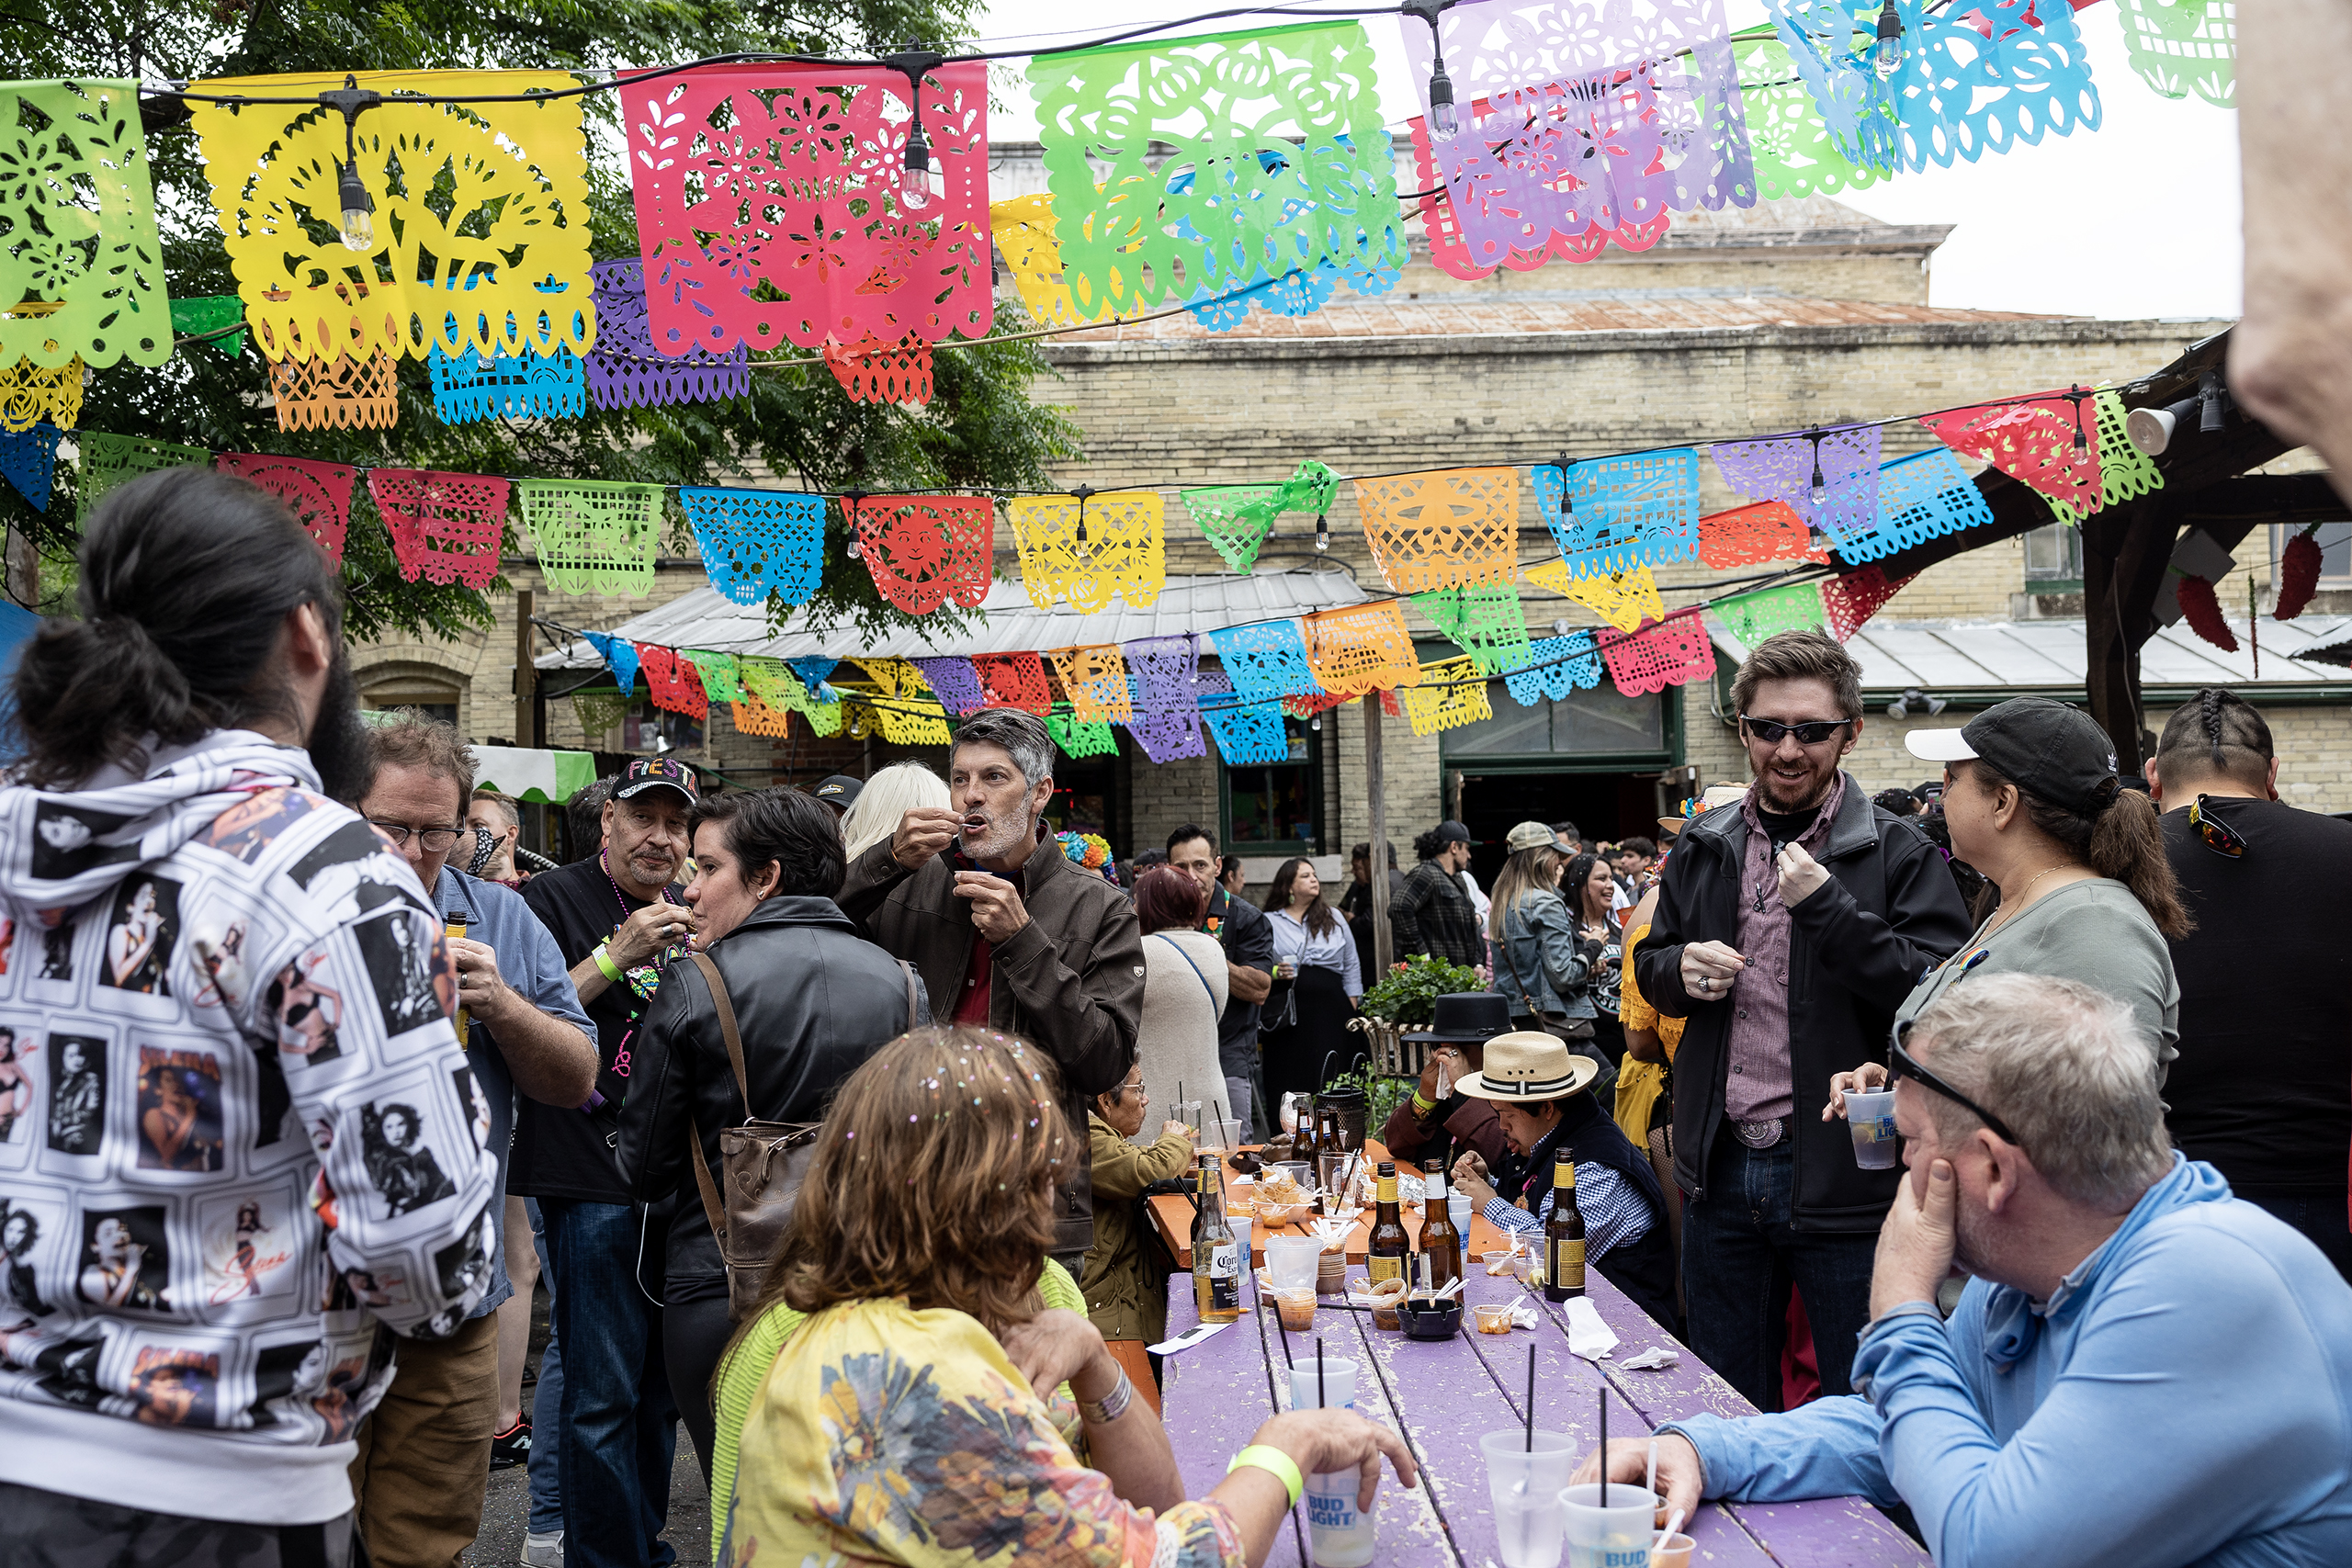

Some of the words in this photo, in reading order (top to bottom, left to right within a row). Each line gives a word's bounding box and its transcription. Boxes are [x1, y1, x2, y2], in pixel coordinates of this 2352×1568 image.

[628, 758, 699, 798] FIESTA
[1600, 996, 1622, 1010] SPU
[1883, 1117, 1894, 1128] BU
[1878, 1126, 1895, 1138] LIG
[1459, 1233, 1470, 1242] UD
[1308, 1495, 1344, 1511] BUD
[1307, 1507, 1351, 1526] LIGHT
[1605, 1550, 1645, 1567] BUD
